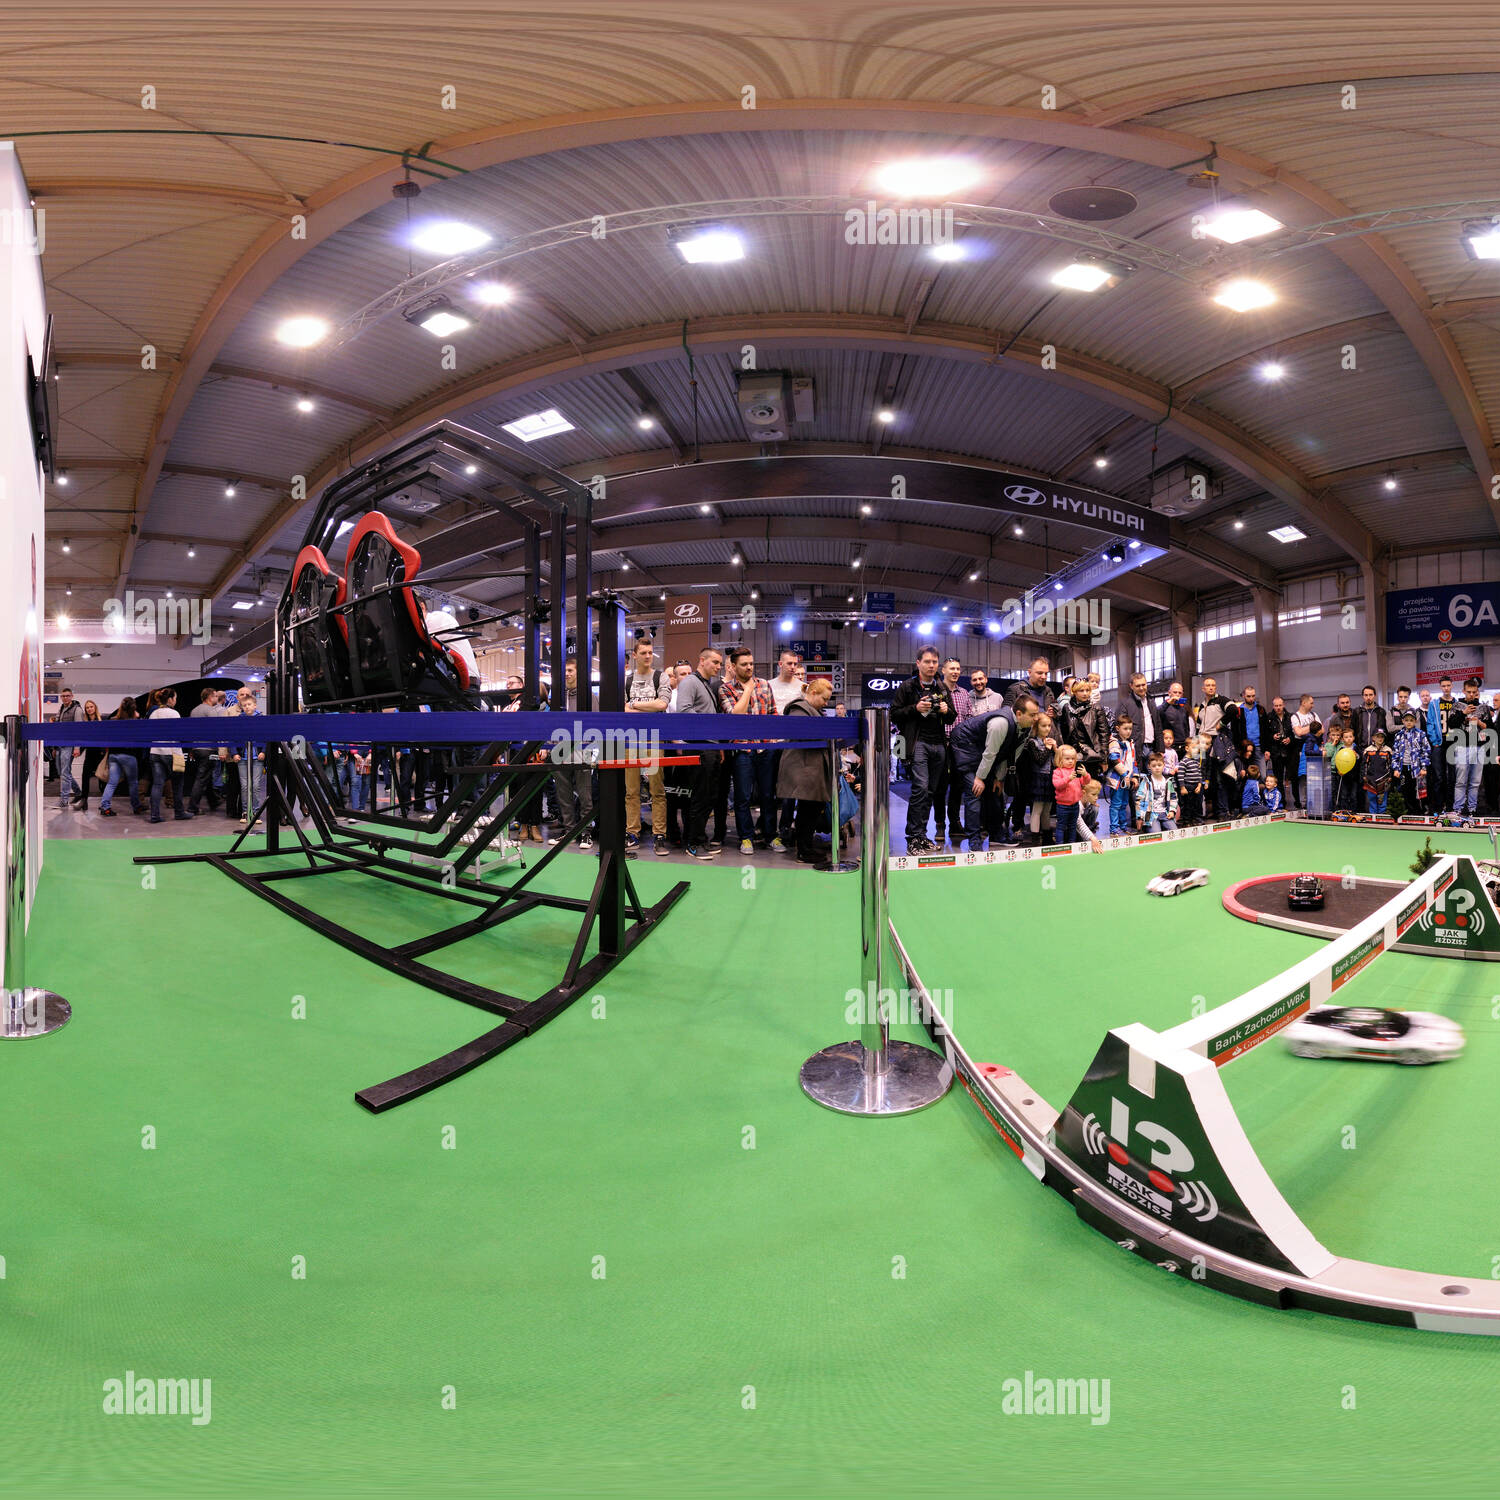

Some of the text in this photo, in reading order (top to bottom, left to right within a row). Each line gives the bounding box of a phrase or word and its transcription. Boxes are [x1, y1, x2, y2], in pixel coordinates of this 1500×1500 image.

[1052, 494, 1145, 531] HYUNDAI
[670, 617, 704, 625] HYUNDAI
[1408, 605, 1441, 615] pawilonu
[1448, 594, 1500, 628] 6A
[815, 643, 822, 652] 5
[1215, 991, 1305, 1051] Bank Zachodni WBK
[1120, 1175, 1153, 1200] JAK
